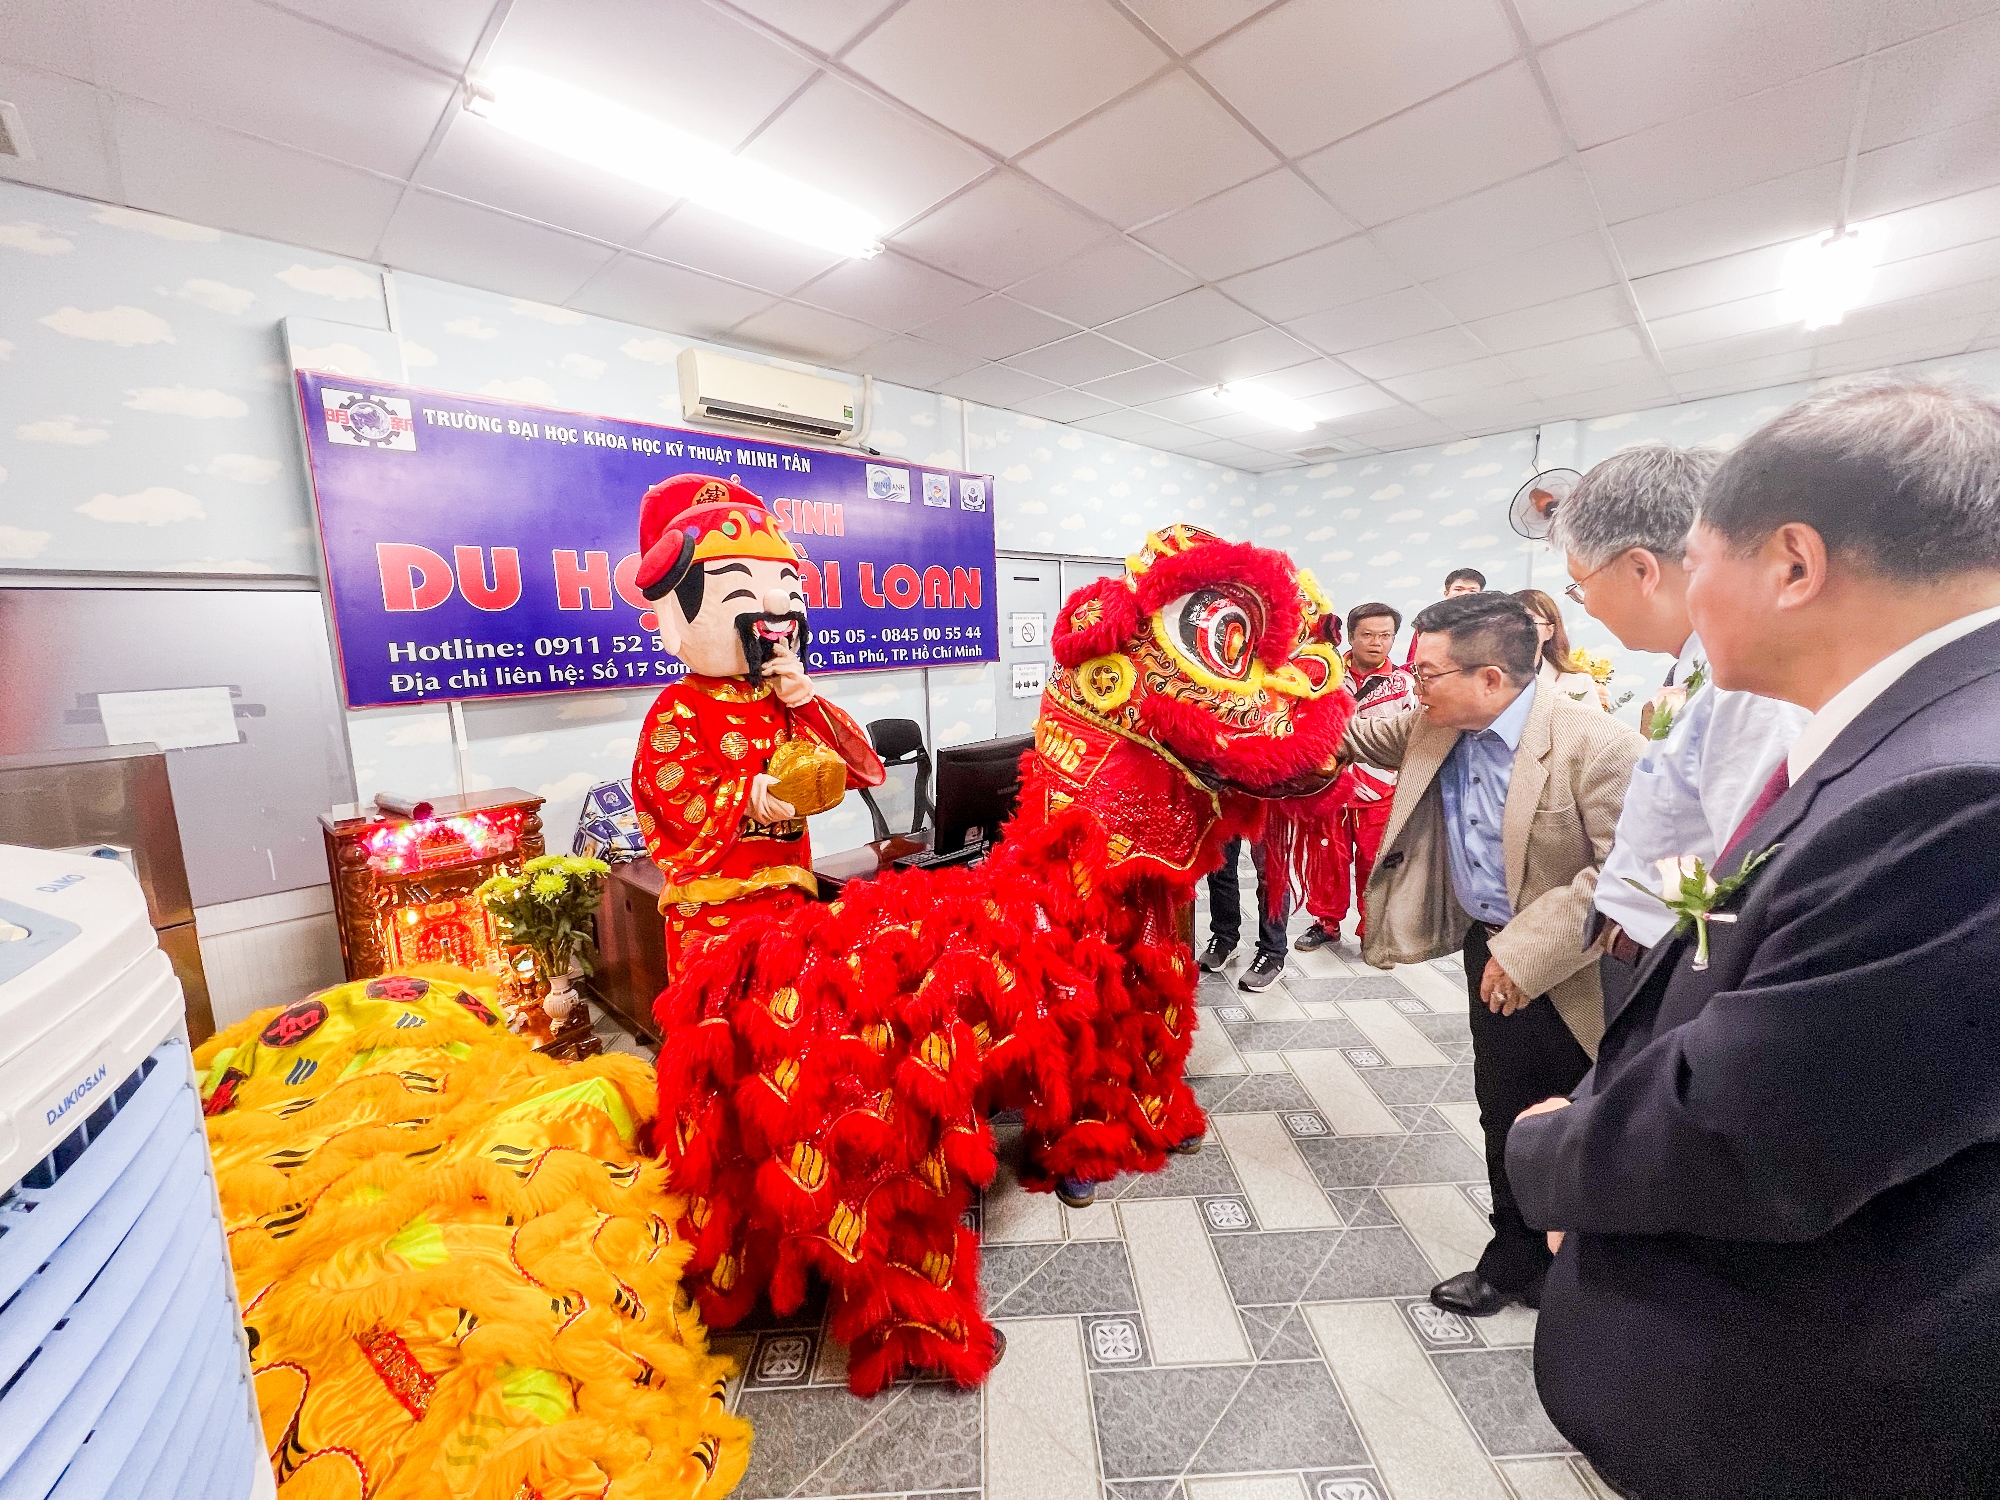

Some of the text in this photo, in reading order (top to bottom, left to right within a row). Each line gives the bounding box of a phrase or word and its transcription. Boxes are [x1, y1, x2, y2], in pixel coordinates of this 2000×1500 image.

[422, 408, 812, 473] TRƯỜNG ĐẠI HỌC KHOA HỌC KỸ THUẬT MINH TÂN
[891, 482, 906, 492] ANH
[772, 498, 845, 537] SINH
[375, 542, 523, 612] DU
[790, 543, 842, 609] ÀI
[858, 561, 982, 609] LOAN
[388, 637, 524, 663] Hotline:
[534, 635, 600, 656] 0911
[612, 635, 644, 653] 52
[818, 629, 841, 645] 05
[845, 628, 866, 644] 05
[881, 627, 919, 642] 0845
[925, 627, 941, 641] 00
[945, 627, 962, 640] 55
[965, 626, 982, 639] 44
[390, 673, 441, 697] Địa
[448, 668, 488, 689] chỉ
[495, 665, 542, 685] liên
[549, 663, 585, 686] hệ:
[591, 657, 619, 681] Số
[624, 661, 649, 677] 17
[809, 652, 828, 669] Q.
[830, 650, 855, 665] Tân
[859, 647, 888, 664] Phú,
[891, 648, 909, 662] TP.
[912, 643, 930, 660] Hồ
[931, 645, 952, 658] Chí
[954, 644, 982, 657] Minh
